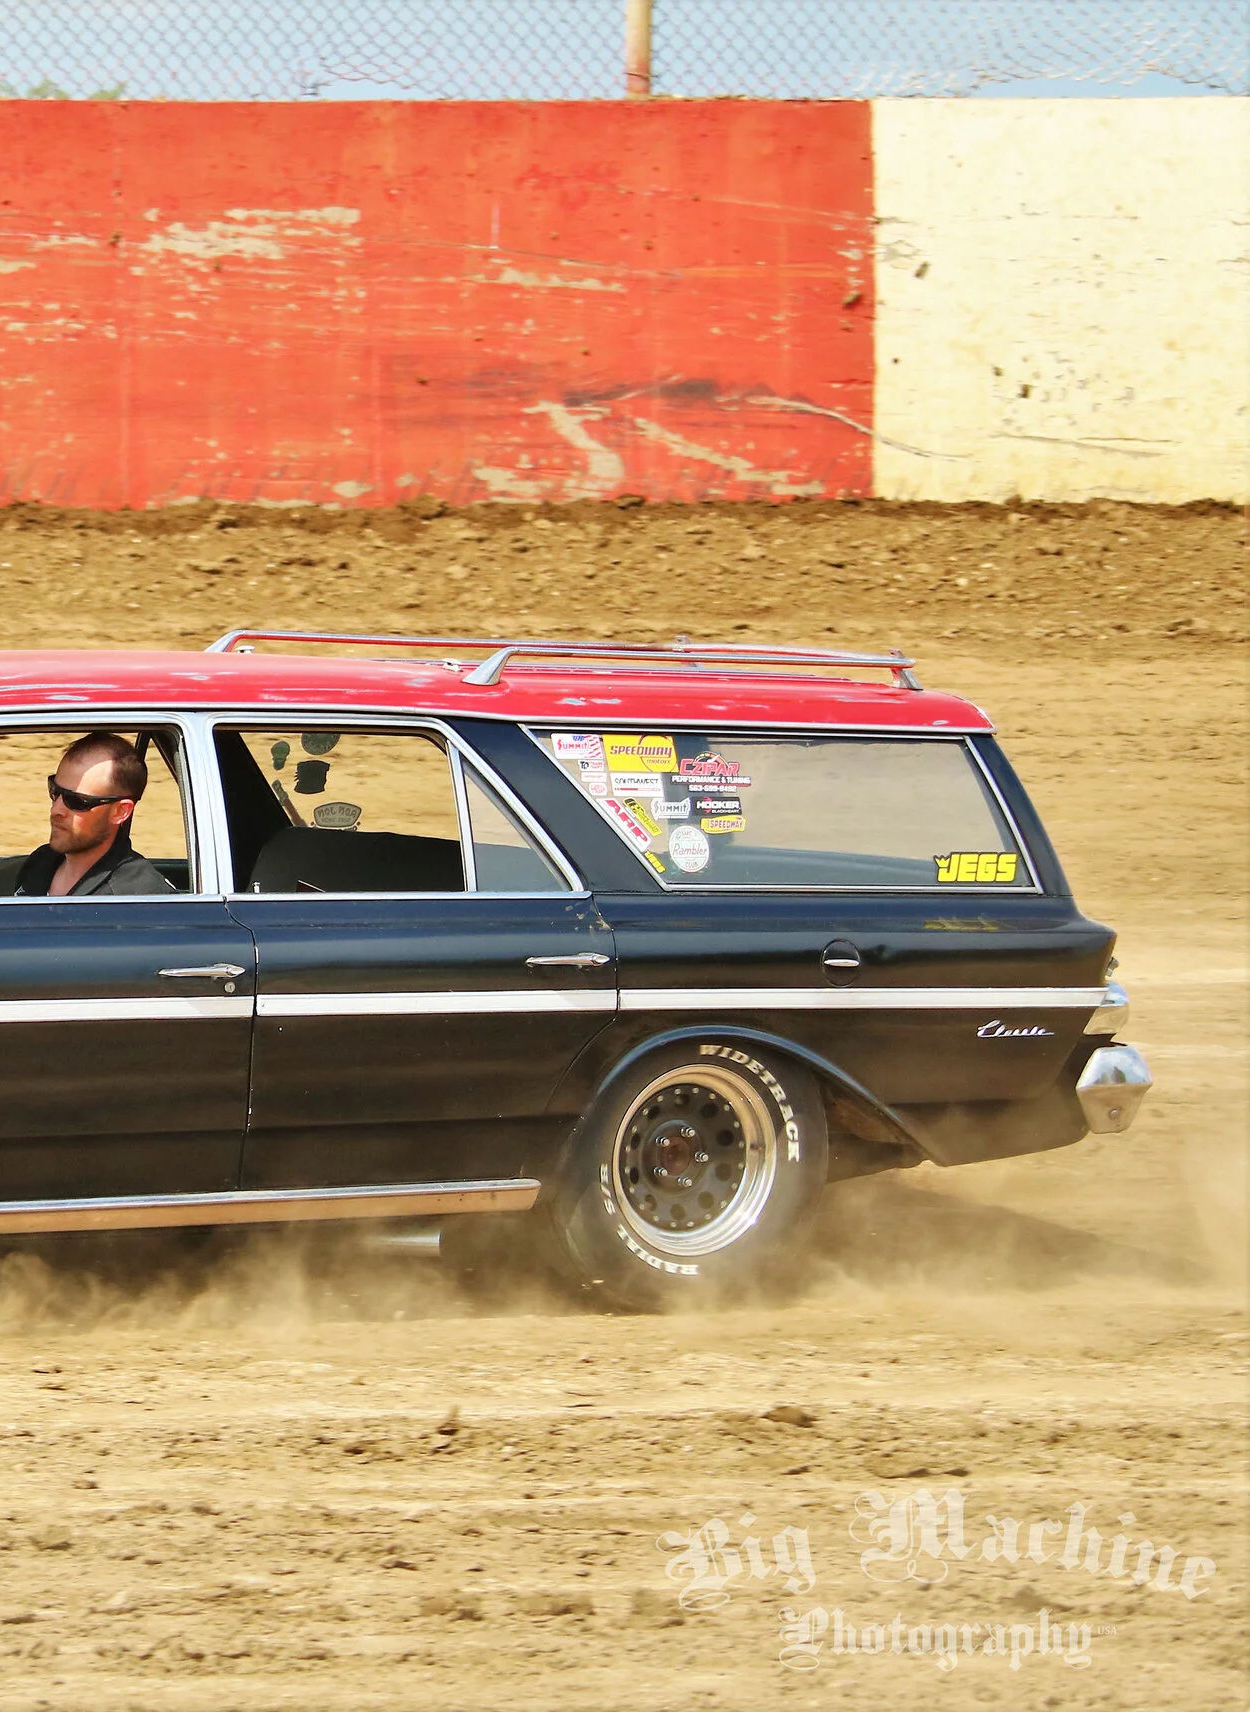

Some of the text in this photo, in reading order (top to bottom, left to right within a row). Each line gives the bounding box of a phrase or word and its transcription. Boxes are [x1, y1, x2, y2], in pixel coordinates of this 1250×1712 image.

[609, 745, 672, 758] SPEEDWAY
[680, 759, 739, 775] CZIPAR
[671, 775, 721, 784] PERFORMANCE
[696, 800, 740, 809] HOOKER
[605, 799, 649, 842] ARP
[672, 842, 708, 856] Rambler
[936, 852, 1019, 883] JEGS
[976, 1020, 1055, 1038] Classic
[699, 1044, 800, 1163] WIDETRACK
